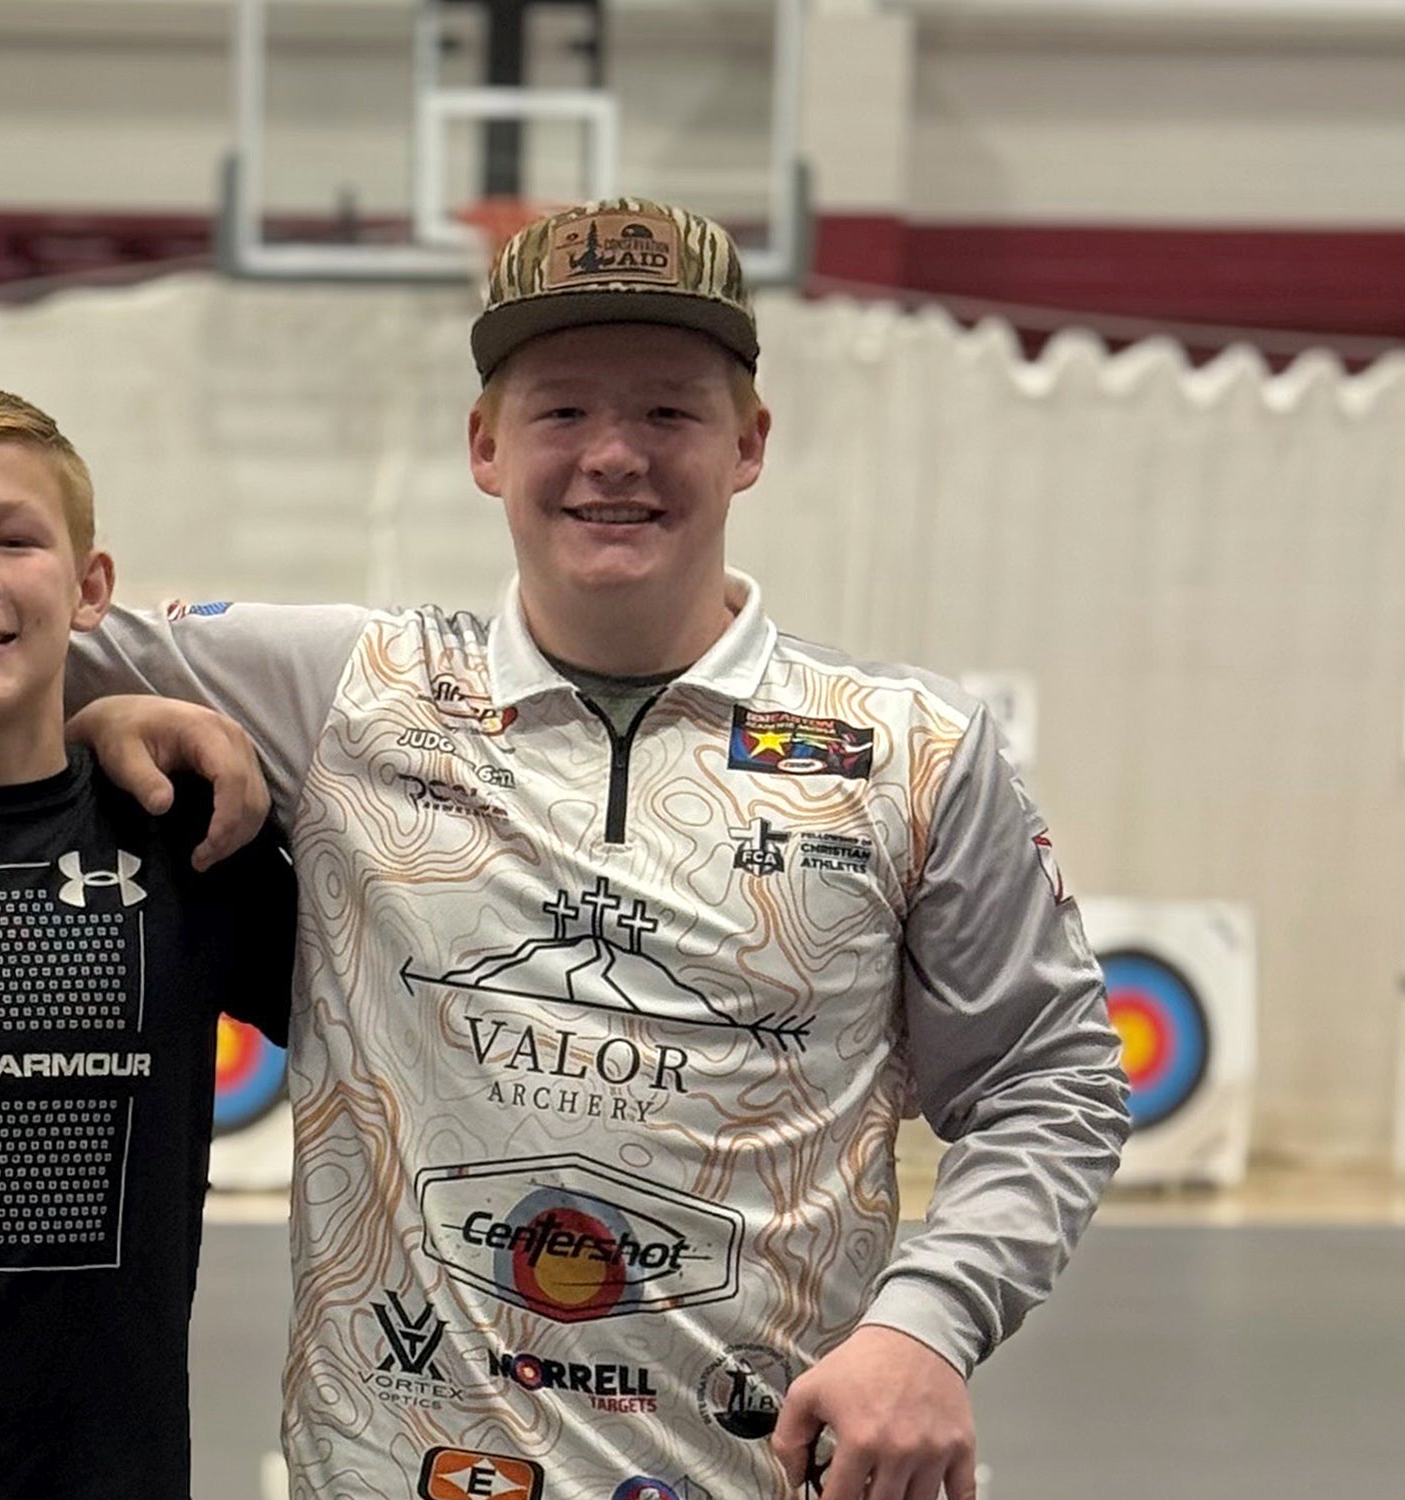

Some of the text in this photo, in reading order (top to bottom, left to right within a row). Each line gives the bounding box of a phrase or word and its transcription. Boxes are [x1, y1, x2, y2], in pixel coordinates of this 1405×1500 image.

[616, 251, 668, 268] AID
[741, 851, 777, 866] FCA
[800, 842, 872, 861] CHRISTIAN
[799, 857, 867, 874] ATHLETES
[464, 1016, 690, 1093] VALOR
[487, 1080, 655, 1122] ARCHERY
[461, 1210, 691, 1270] Centershot
[487, 1348, 657, 1396] MORRELL
[358, 1371, 464, 1401] VORTEX
[378, 1391, 443, 1410] OPTICS
[589, 1395, 658, 1414] TARGETS
